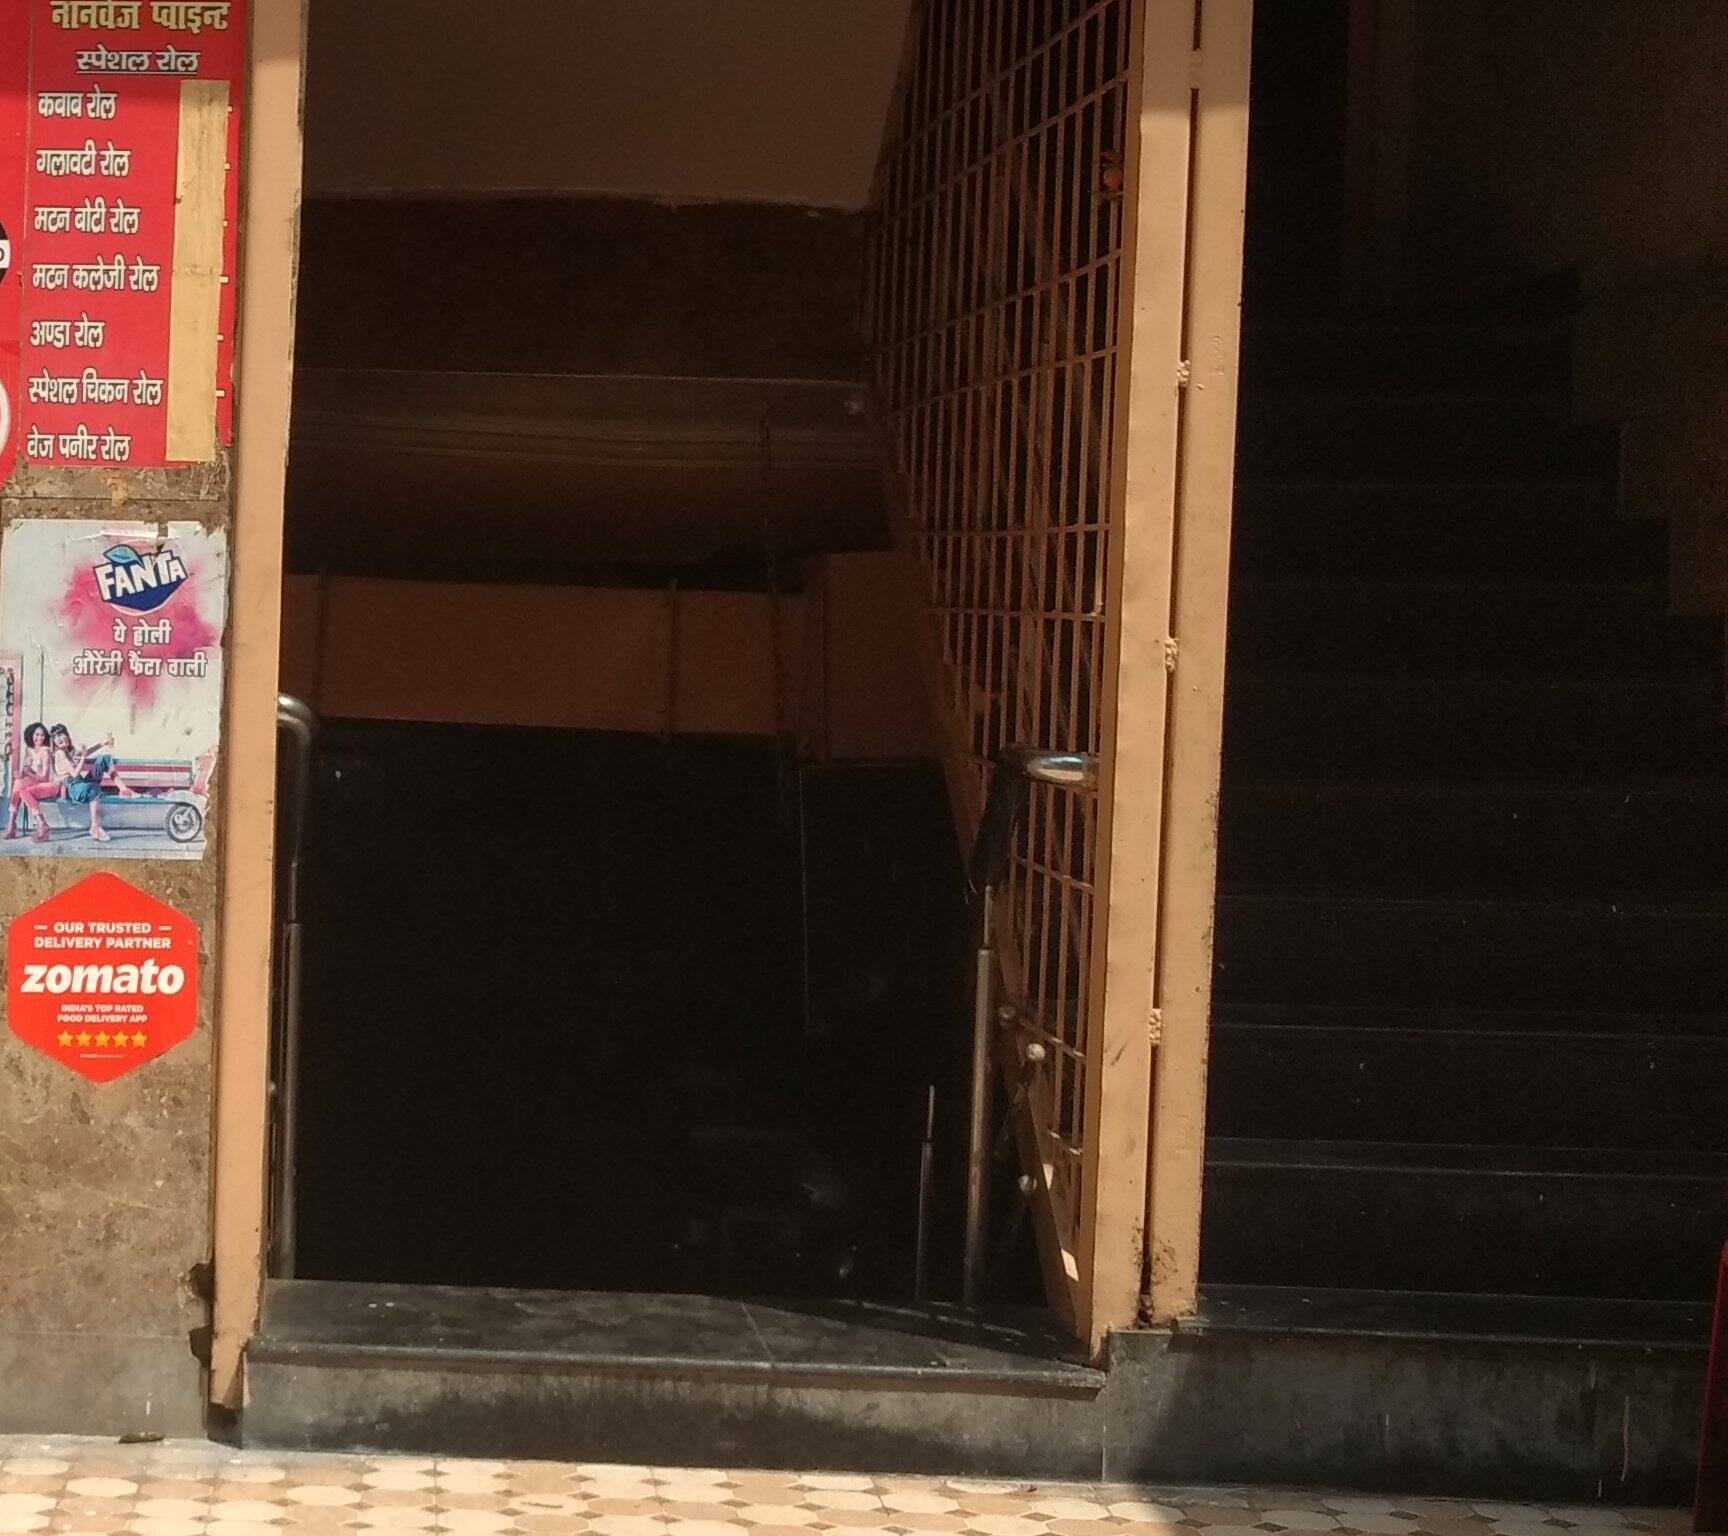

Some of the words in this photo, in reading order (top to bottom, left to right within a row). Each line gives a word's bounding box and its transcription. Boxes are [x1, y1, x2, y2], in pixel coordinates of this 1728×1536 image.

[149, 0, 231, 34] प्वाइन्ट
[76, 44, 151, 71] स्पेशल
[156, 44, 201, 71] रोल
[86, 83, 118, 119] रोल
[36, 139, 96, 175] गलावटी
[100, 140, 131, 176] रोल
[34, 207, 70, 233] मटन
[75, 197, 107, 233] बोटी
[110, 199, 140, 234] रोल
[33, 264, 68, 290] मटन
[72, 253, 126, 291] कलेजी
[129, 256, 160, 292] रोल
[29, 321, 71, 348] अण्डा
[75, 313, 105, 349] रोल
[28, 367, 80, 404] स्पेशल
[82, 367, 130, 404] चिकन
[133, 369, 163, 405] रोल
[26, 424, 55, 459] वेज
[59, 423, 99, 460] पनीर
[101, 425, 132, 462] रोल
[94, 549, 186, 601] FANTA
[112, 618, 127, 644] ये
[132, 618, 173, 647] होली
[167, 651, 208, 677] वाली
[34, 937, 102, 949] DELIVERY
[106, 937, 172, 949] PARTNER
[54, 922, 85, 934] OUR
[88, 922, 152, 934] TRUSTED
[21, 958, 185, 994] zomato
[57, 1014, 83, 1023] FOOD
[85, 1014, 127, 1023] DELIVERY
[129, 1014, 148, 1023] APP
[95, 1004, 113, 1013] TOP
[115, 1004, 144, 1013] RATED
